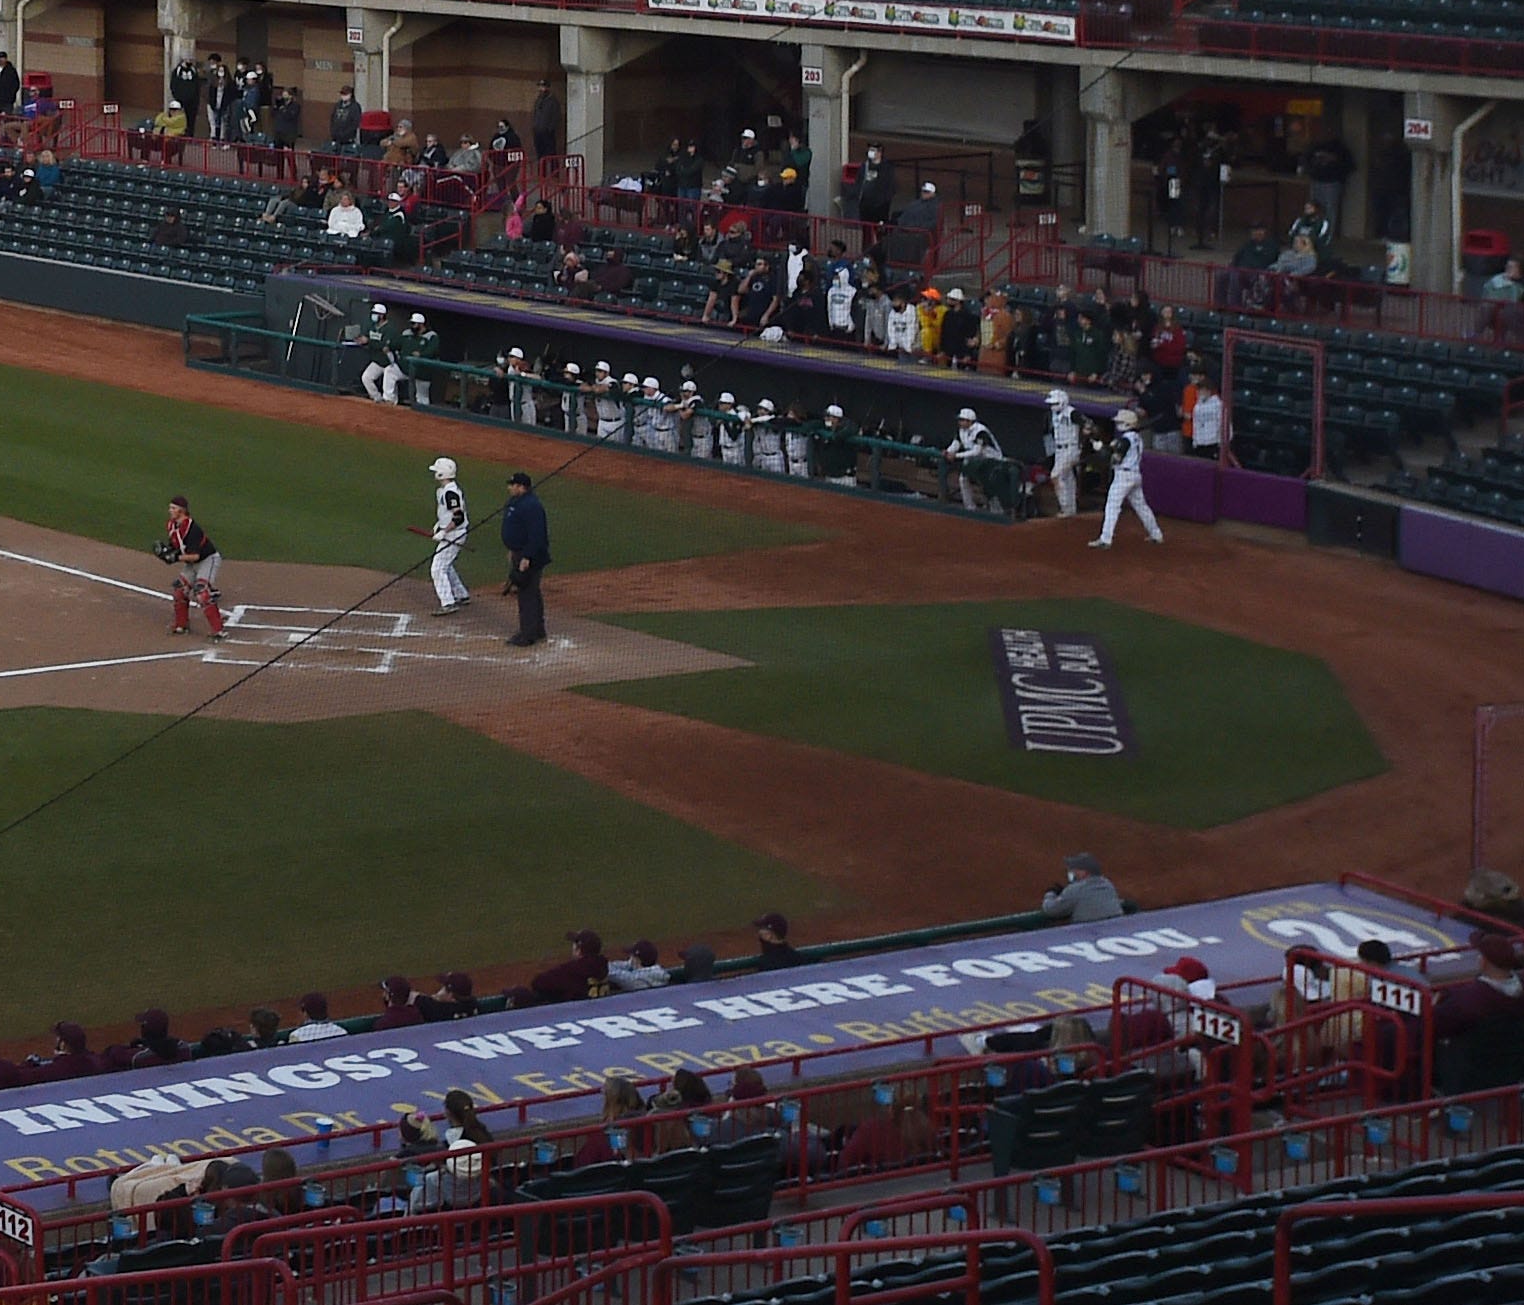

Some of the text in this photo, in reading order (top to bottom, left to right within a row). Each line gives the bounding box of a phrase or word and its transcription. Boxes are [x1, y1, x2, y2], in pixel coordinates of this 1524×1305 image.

[804, 70, 821, 83] 203
[1407, 122, 1429, 136] 204
[1011, 672, 1125, 755] UPMC
[1267, 910, 1431, 961] 24
[433, 1007, 703, 1060] WE'RE
[695, 972, 915, 1021] HERE
[902, 951, 1074, 989] FOR
[1052, 927, 1223, 963] YOU.
[1376, 983, 1415, 1011] 111
[1197, 1013, 1236, 1040] 112
[4, 1126, 292, 1182] Rotunda
[635, 1035, 812, 1076] Plaza
[833, 1000, 1042, 1045] Buffalo
